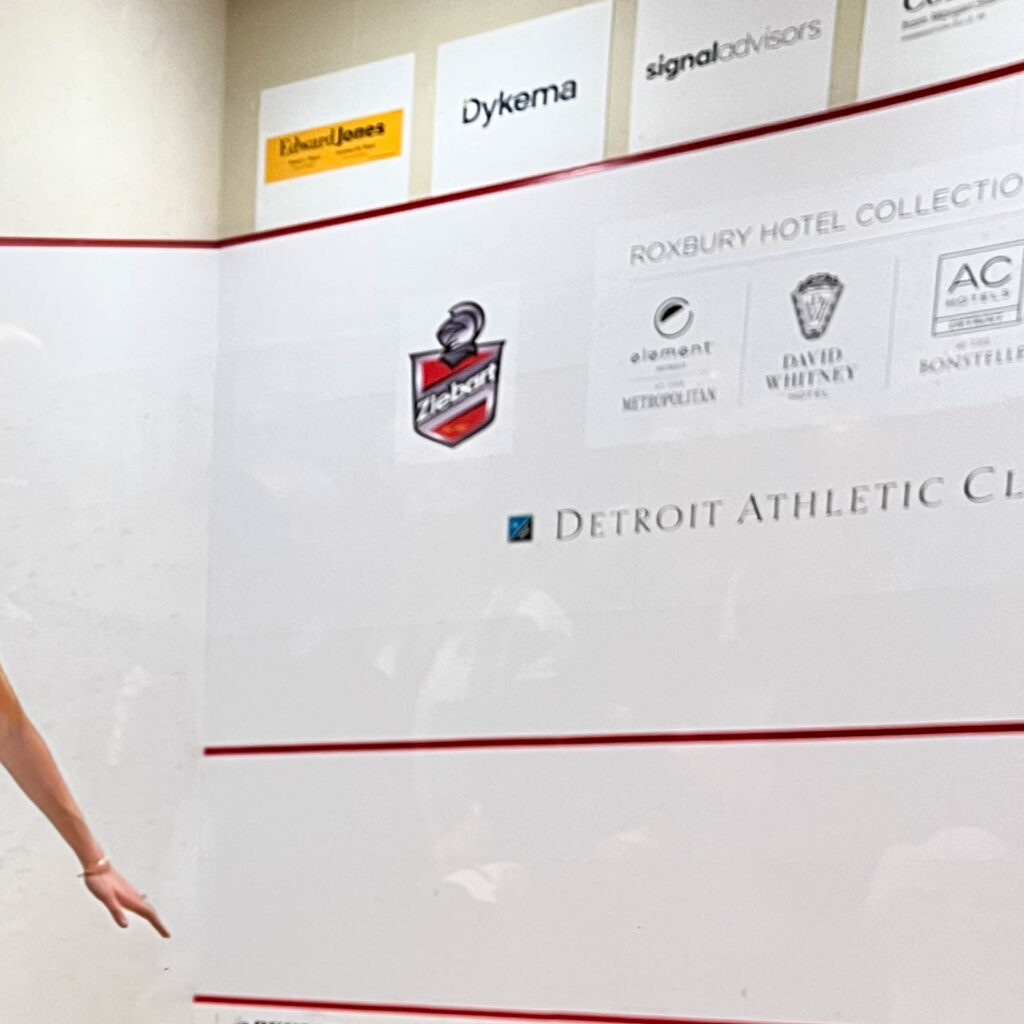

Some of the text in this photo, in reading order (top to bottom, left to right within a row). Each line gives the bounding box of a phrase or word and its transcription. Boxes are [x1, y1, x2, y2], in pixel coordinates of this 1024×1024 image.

[462, 79, 577, 128] Dykema
[630, 225, 753, 265] ROXBURY
[760, 210, 846, 244] HOTEL
[947, 254, 1013, 293] AC
[630, 341, 712, 363] element
[782, 347, 843, 369] DAVID
[416, 362, 497, 422] Ziebart
[765, 364, 858, 389] WHITNEY
[555, 499, 724, 541] DETROIT
[737, 476, 945, 525] ATHLETIC
